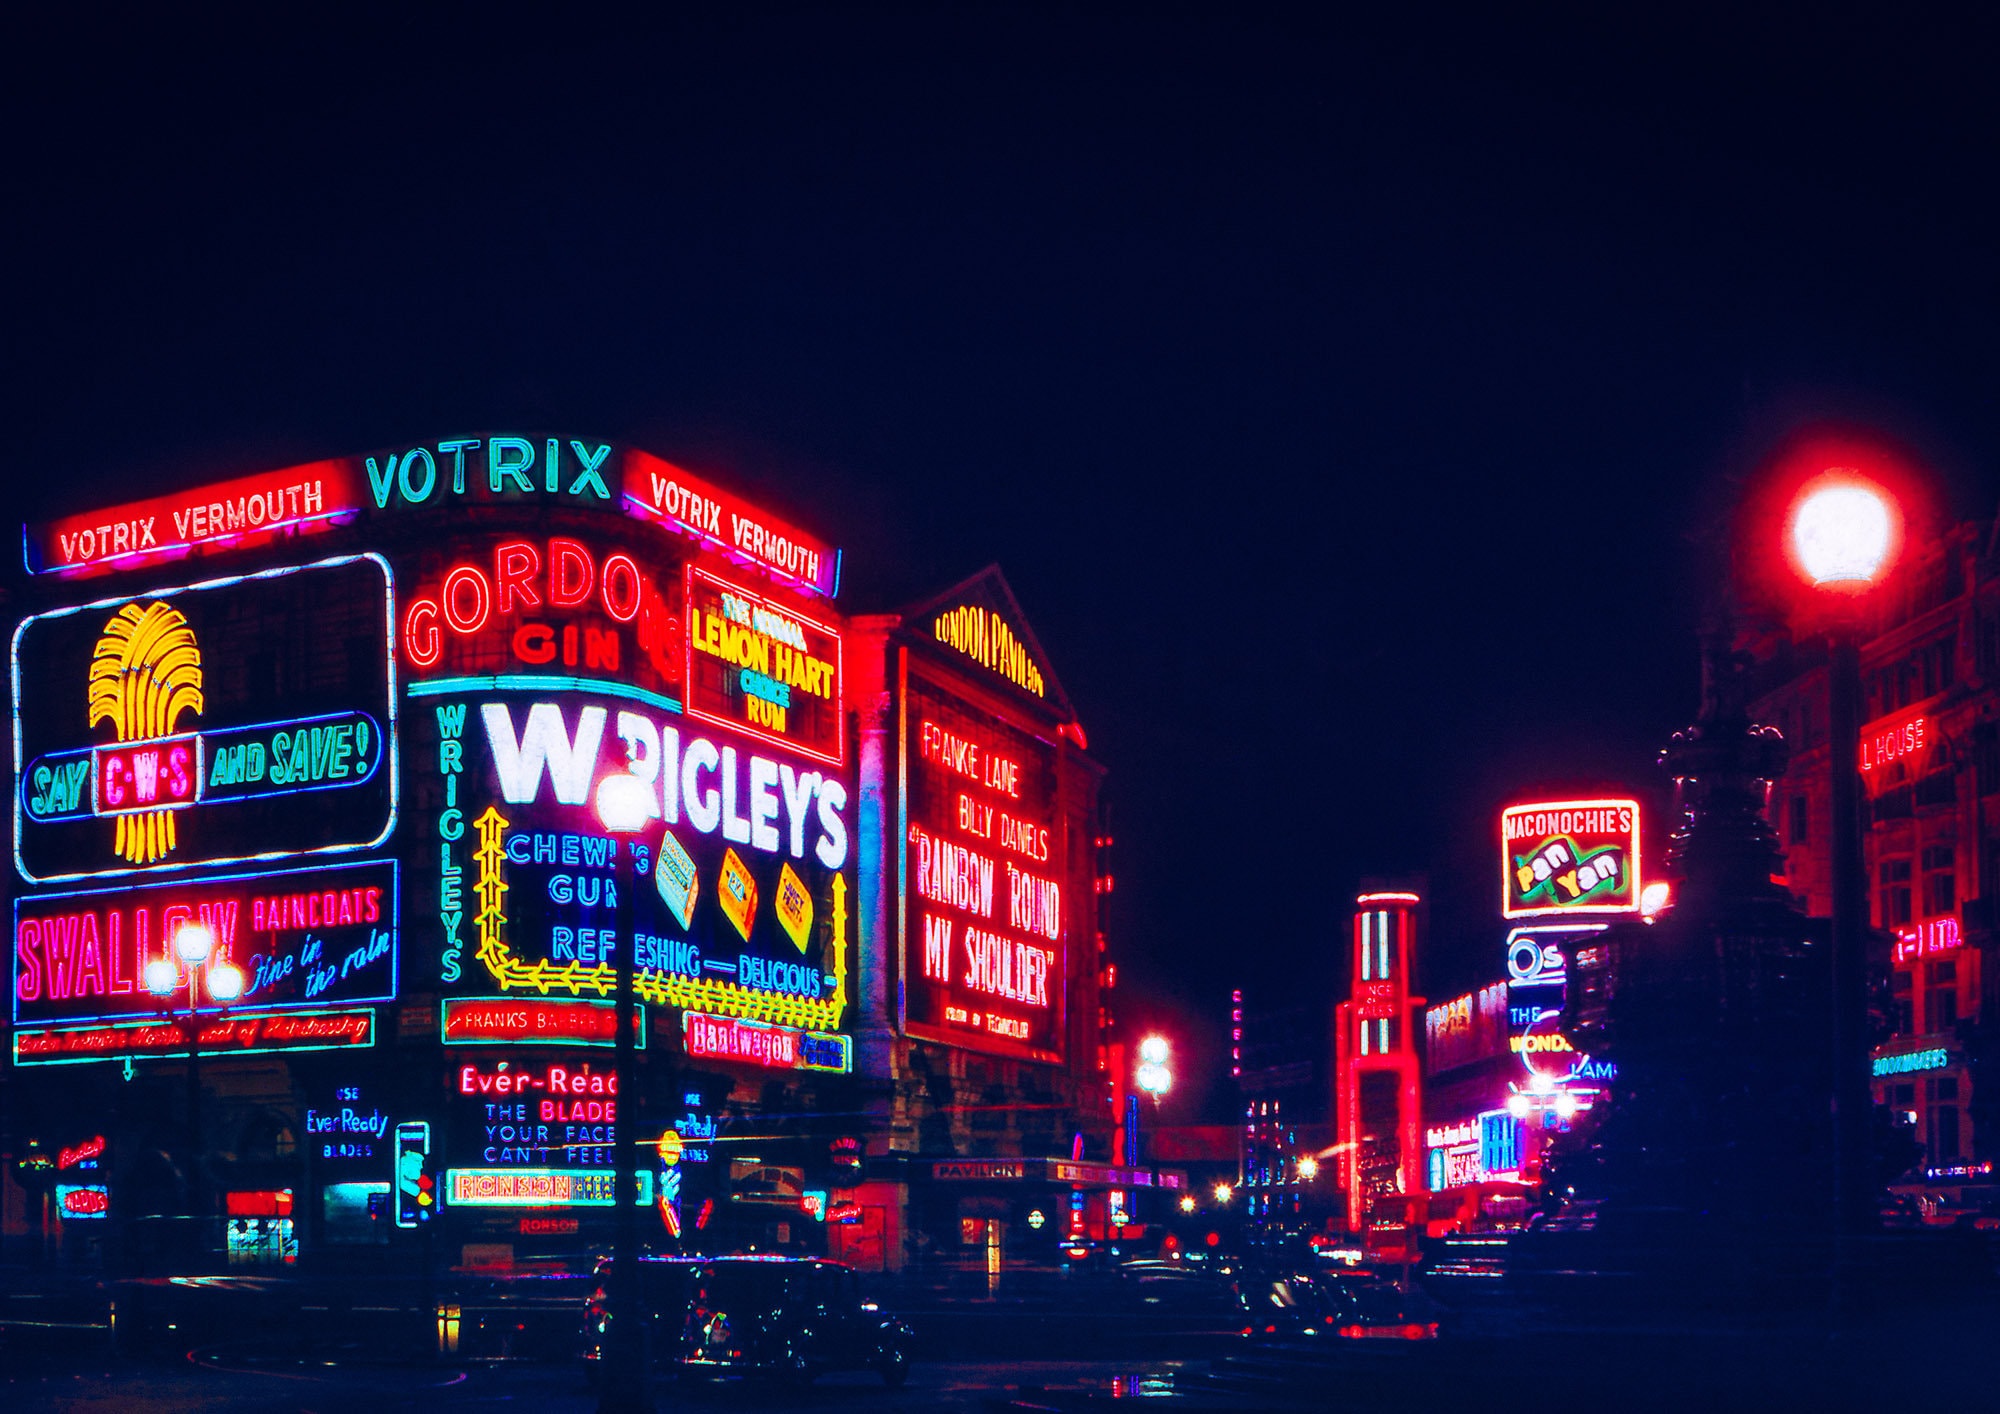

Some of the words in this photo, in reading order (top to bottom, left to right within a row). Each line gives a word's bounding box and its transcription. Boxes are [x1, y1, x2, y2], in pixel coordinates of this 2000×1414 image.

[365, 437, 611, 507] VOTRIX
[61, 516, 156, 563] VOTRIX
[173, 480, 322, 540] VERMOUTH
[650, 472, 721, 535] VOTRIX
[731, 512, 820, 582] VERMOUTH
[512, 624, 619, 671] GIN
[692, 608, 769, 674] LEMON
[775, 643, 834, 699] HART
[935, 605, 989, 667] LONDON
[991, 612, 1044, 698] PAVILION
[746, 694, 786, 732] RUM
[1876, 718, 1924, 765] HOUSE
[31, 760, 90, 815] SAY
[210, 743, 265, 787] AND
[270, 722, 370, 785] SAVE!
[480, 703, 848, 869] WRIGLEY'S
[960, 794, 993, 838] BILLY
[1506, 808, 1632, 840] MACONOCHIE'S
[437, 704, 467, 981] WRIGLEY'S
[506, 834, 649, 874] CHEWIG
[253, 888, 380, 931] RAINCOATS
[301, 934, 322, 967] in
[341, 928, 390, 979] rain
[925, 914, 952, 982] MY
[1929, 917, 1963, 952] LTD.
[553, 926, 700, 978] REFESHING
[740, 955, 820, 998] DELICIOUS
[1511, 1006, 1542, 1024] THE
[1510, 1035, 1573, 1054] WOND
[1570, 1063, 1617, 1081] LAM
[342, 1108, 389, 1139] Ready
[485, 1104, 526, 1121] THE
[540, 1101, 616, 1122] BLADE
[484, 1143, 551, 1164] CAN'T
[485, 1125, 549, 1142] YOUR
[566, 1126, 615, 1142] FACE
[459, 1176, 569, 1200] RONSON
